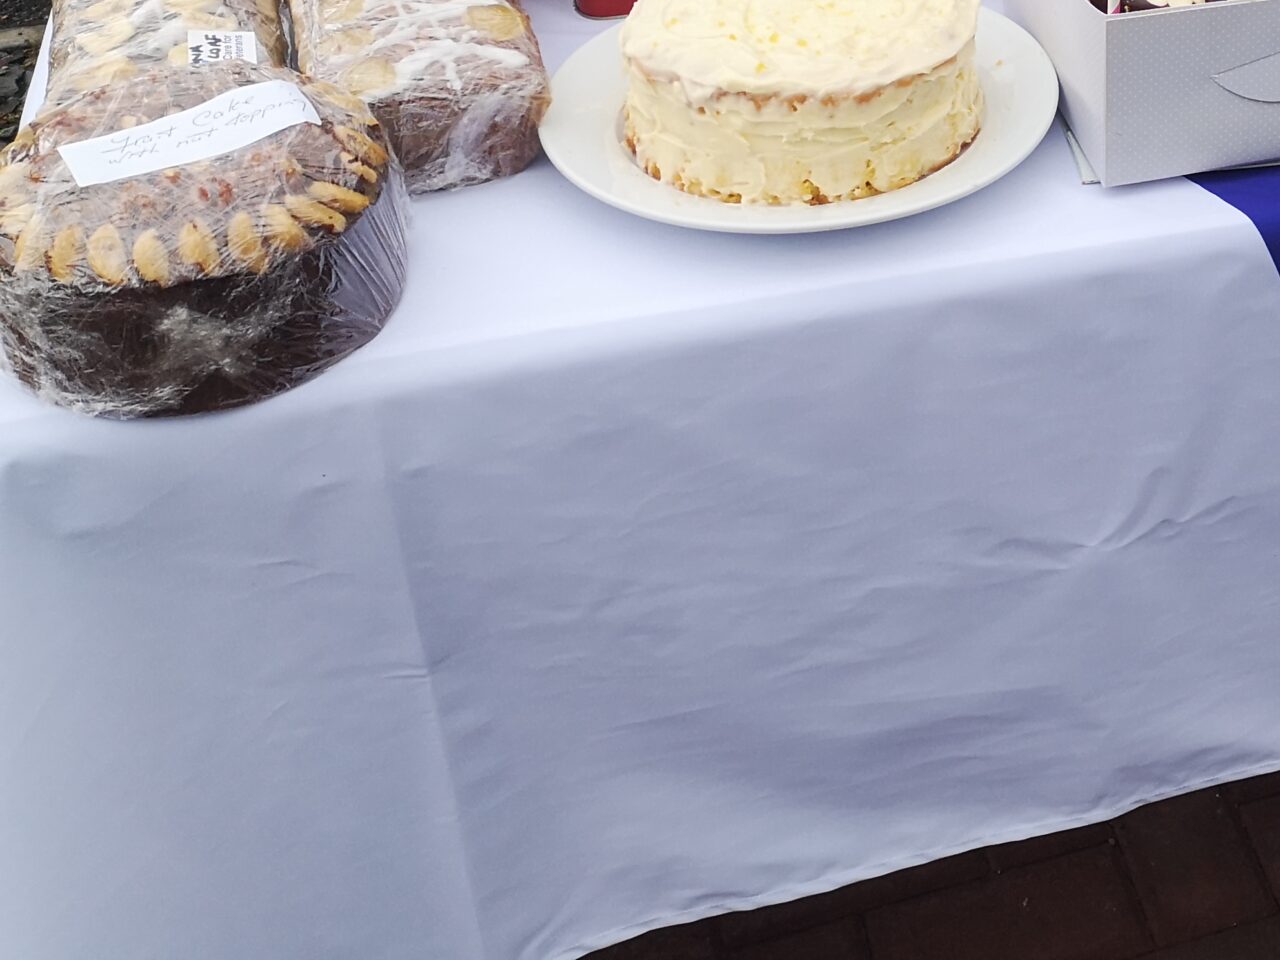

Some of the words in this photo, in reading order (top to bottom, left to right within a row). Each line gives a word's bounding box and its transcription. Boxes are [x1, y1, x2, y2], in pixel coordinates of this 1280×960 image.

[205, 34, 222, 59] LOAF
[222, 35, 232, 44] for
[235, 34, 244, 59] eterans
[223, 45, 232, 60] Care
[192, 95, 255, 127] Cake
